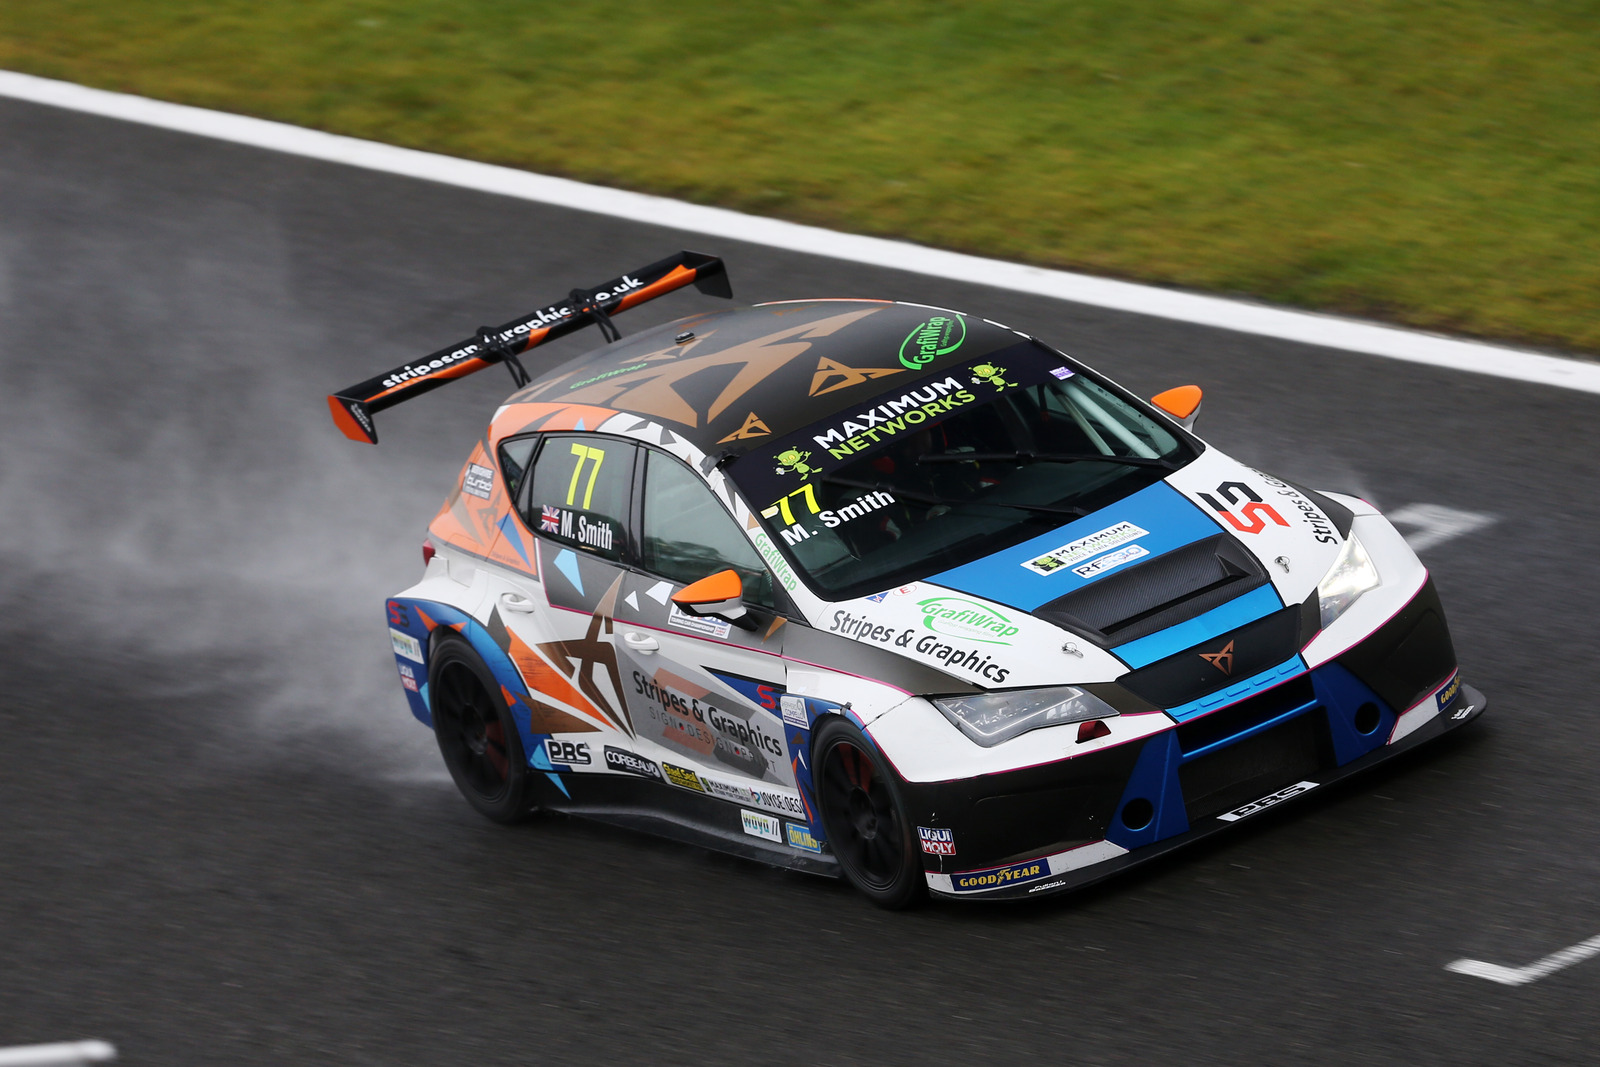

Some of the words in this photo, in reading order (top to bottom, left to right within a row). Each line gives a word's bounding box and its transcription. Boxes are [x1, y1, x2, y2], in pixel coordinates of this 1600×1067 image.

[913, 316, 951, 364] GrafiWrap
[812, 376, 964, 450] MAXIMUM
[827, 389, 977, 461] NETWORKS
[566, 442, 605, 511] 77
[1276, 489, 1300, 501] &
[770, 483, 821, 526] 77
[779, 523, 819, 547] M.
[818, 489, 896, 529] Smith
[1291, 499, 1339, 545] Stripes
[561, 509, 577, 541] M.
[577, 515, 613, 552] Smith
[1054, 523, 1131, 557] MAXIMUM
[1062, 527, 1137, 560] NETWORKS
[754, 532, 798, 592] GrafiWrap
[920, 603, 1020, 638] GrafiWrap
[829, 609, 893, 644] Stripes
[894, 628, 916, 649] &
[914, 634, 1011, 684] Graphics
[632, 670, 689, 717] Stripes
[691, 698, 706, 724] &
[708, 705, 784, 757] Graphics
[649, 706, 678, 731] SIGN
[547, 740, 592, 766] PBS
[919, 828, 951, 842] LIQUI
[922, 840, 954, 854] MOLY
